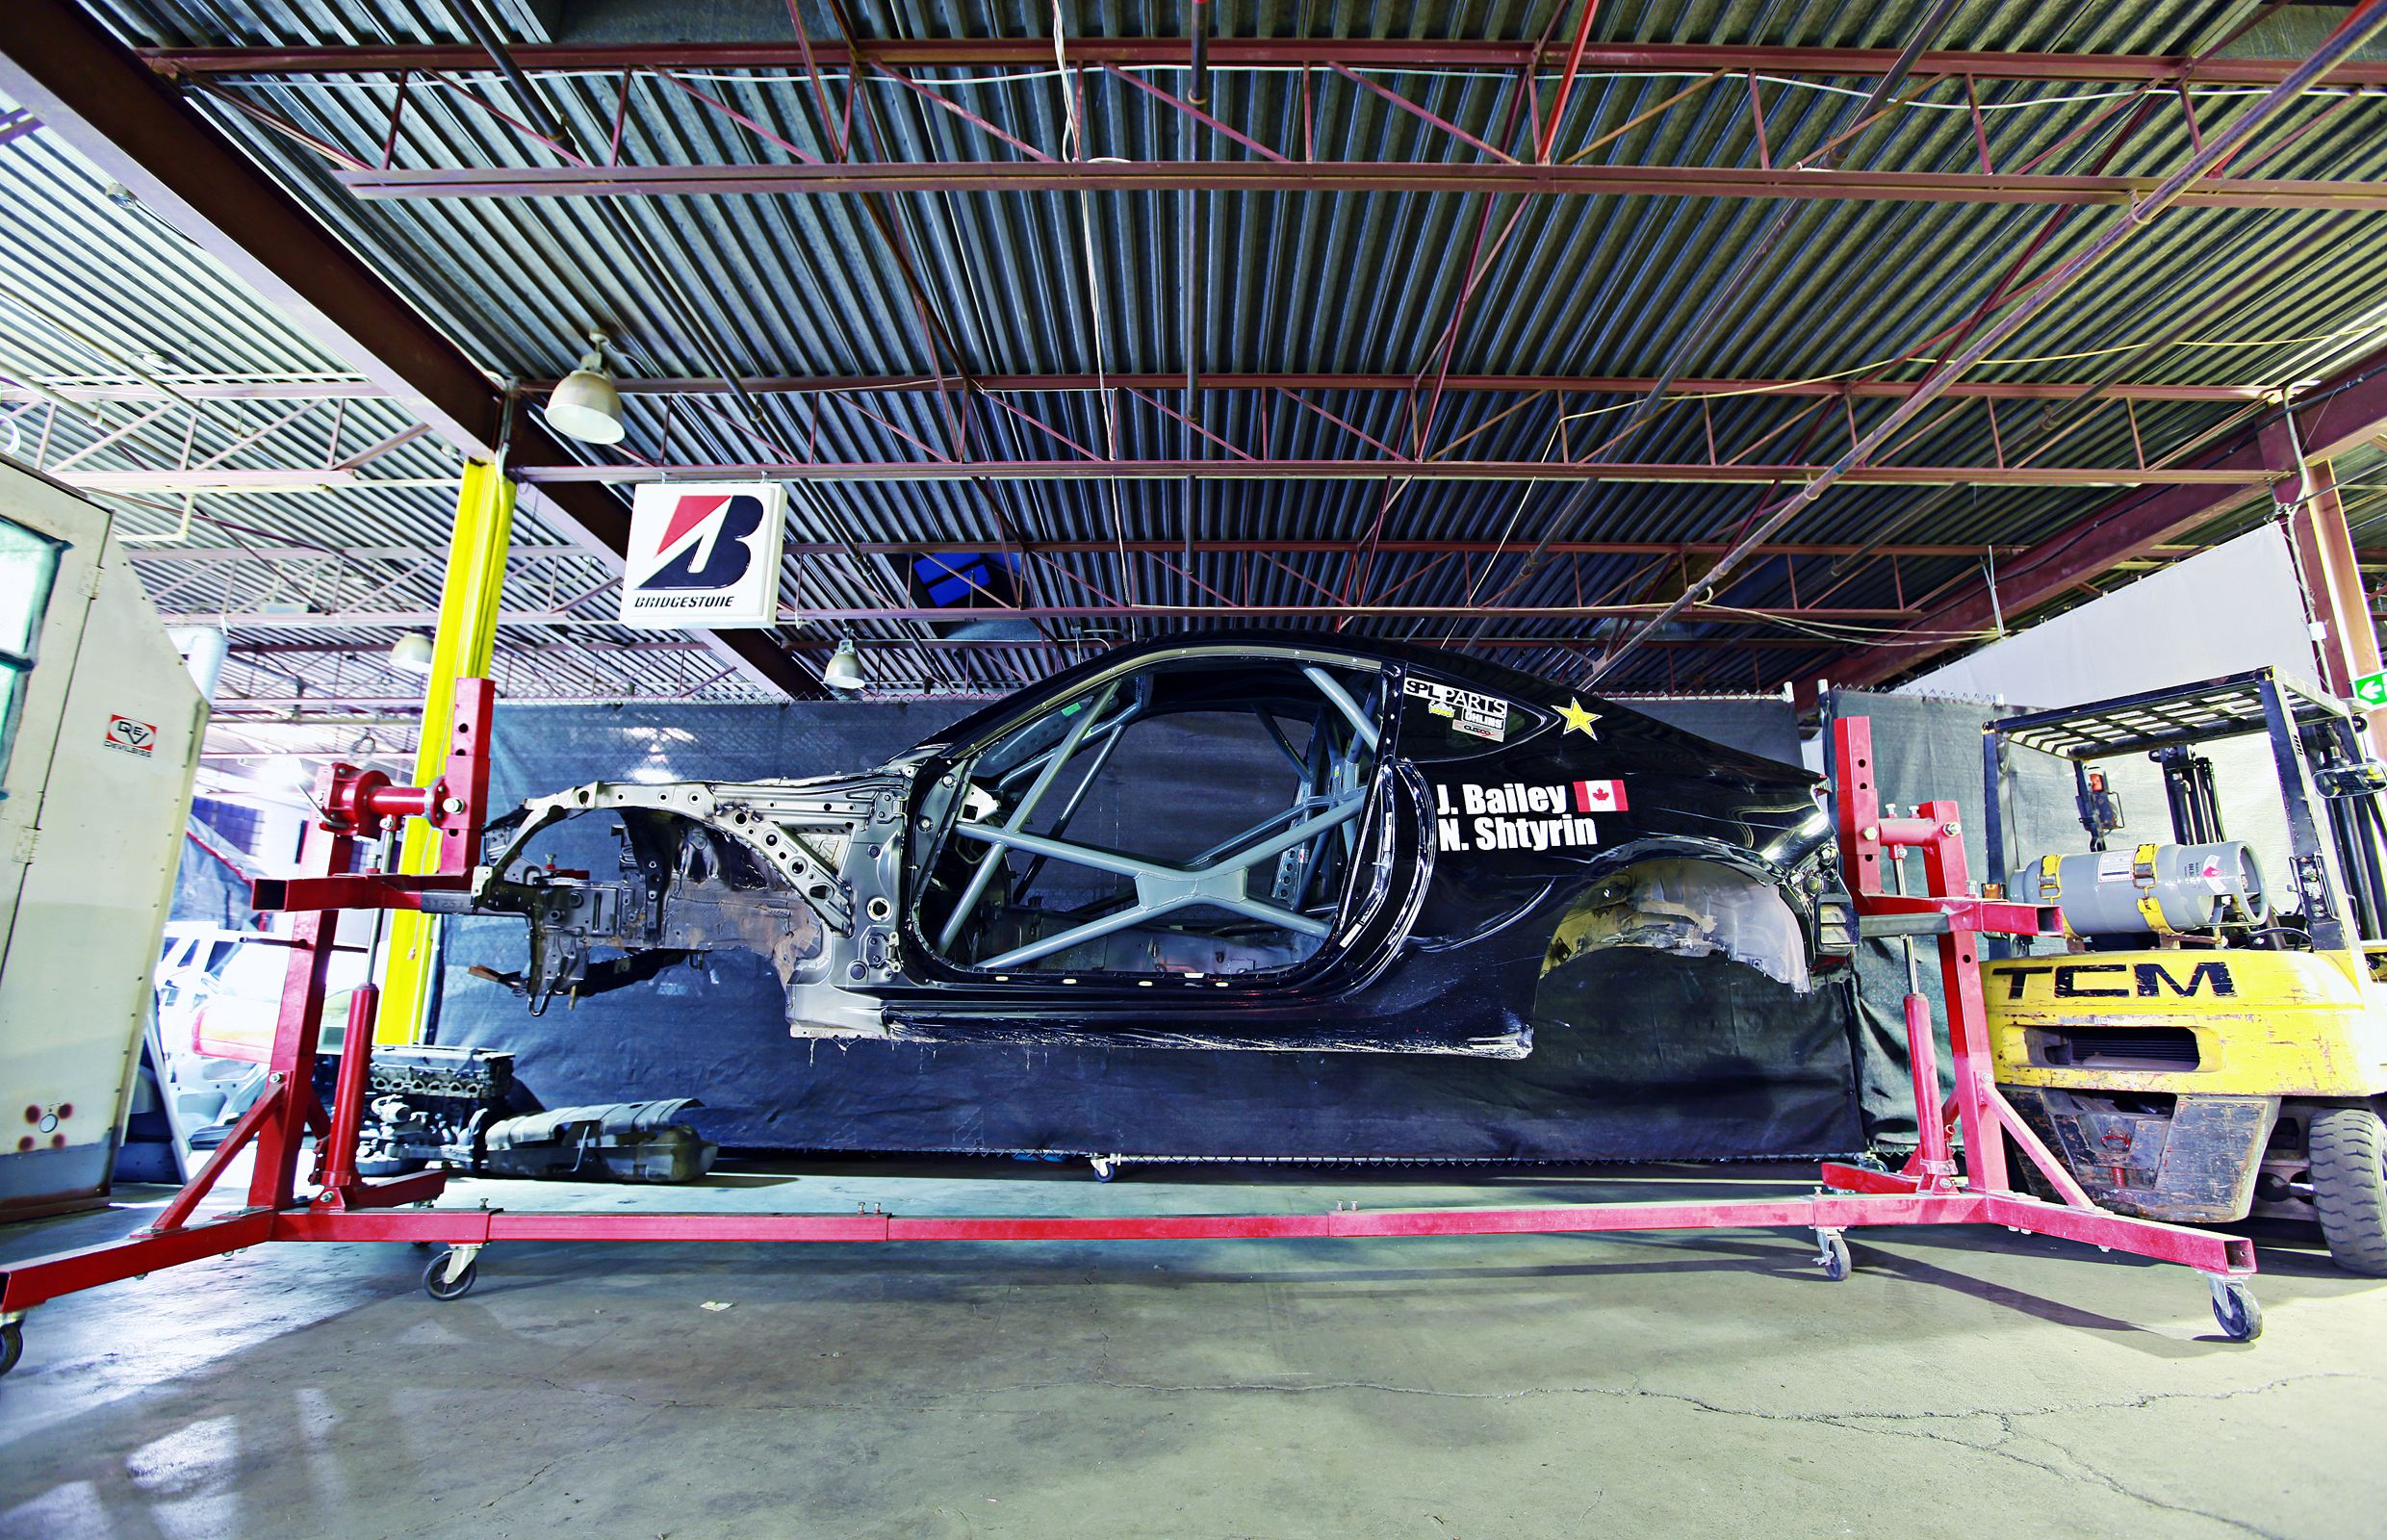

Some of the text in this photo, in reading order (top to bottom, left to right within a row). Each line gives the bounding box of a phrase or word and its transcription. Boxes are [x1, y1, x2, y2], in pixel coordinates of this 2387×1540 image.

[634, 595, 734, 608] BRIDGESTONE
[1405, 680, 1441, 700] SPL
[1445, 689, 1505, 716] PARTS
[1437, 783, 1567, 815] J. Bailey
[1437, 813, 1599, 852] N. Shtyrin
[1992, 962, 2238, 998] TCM
